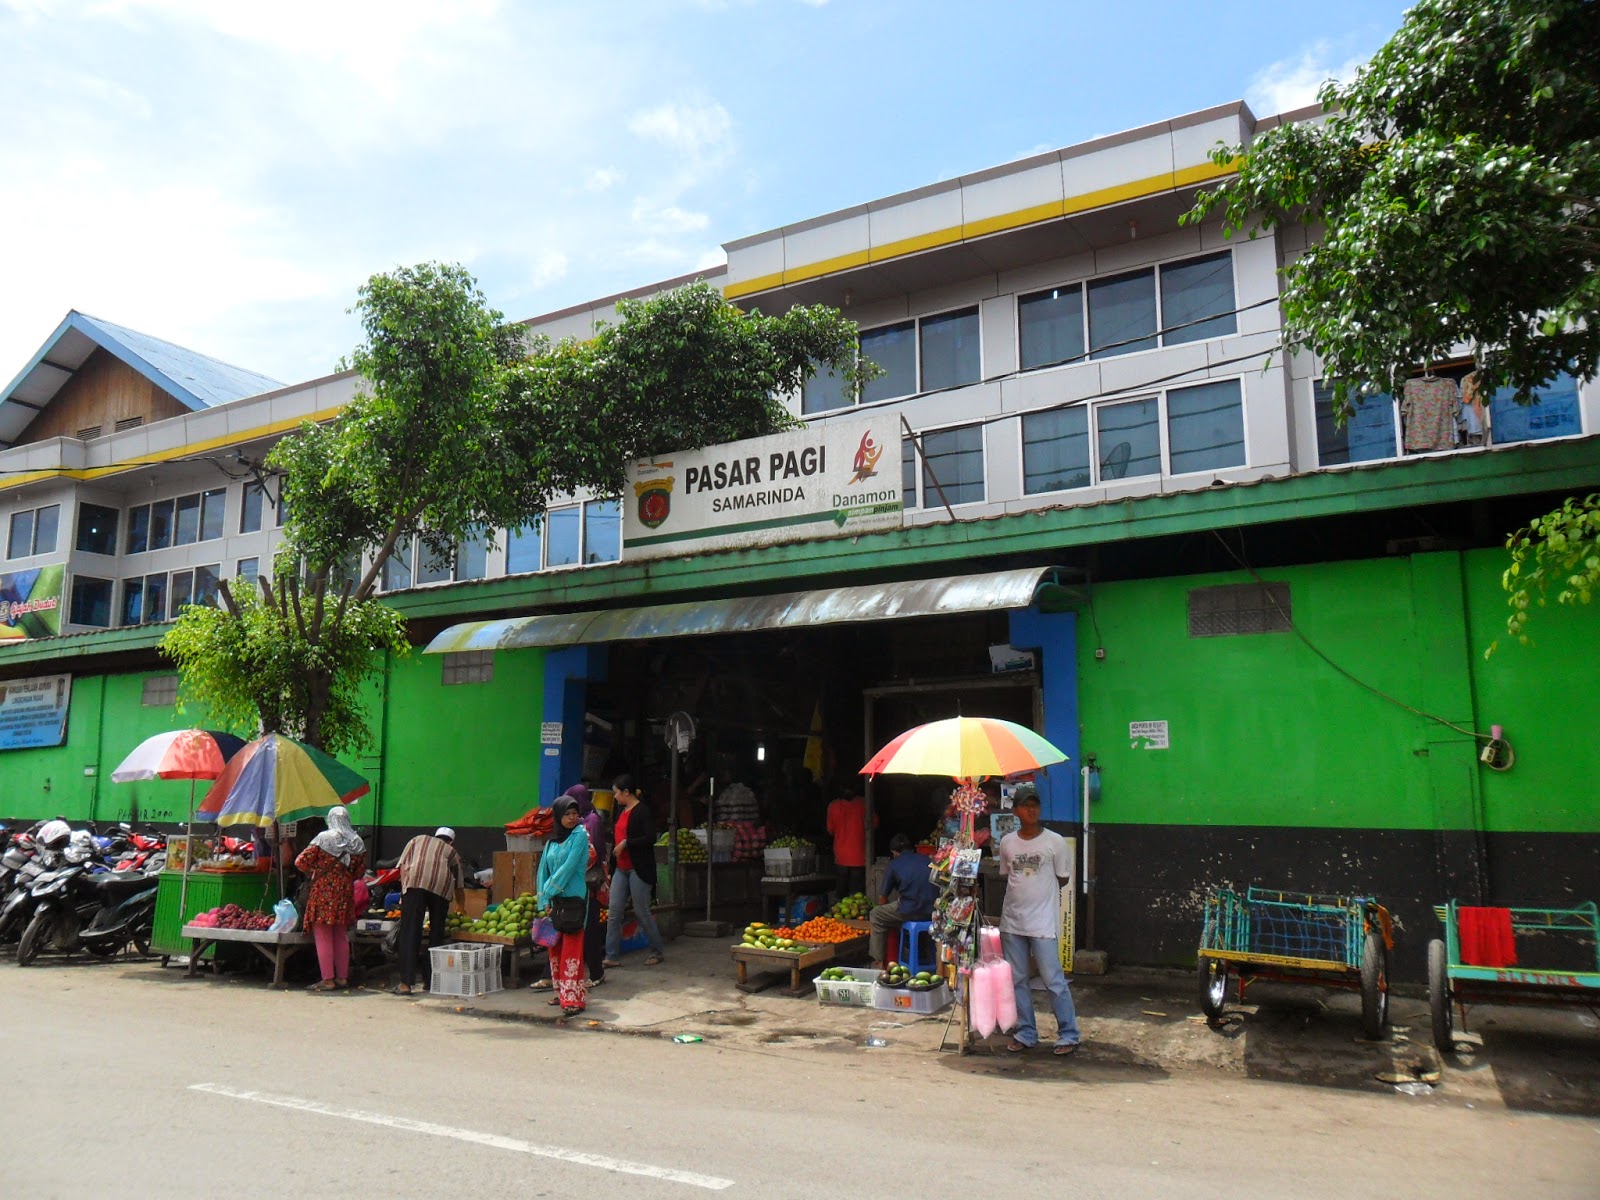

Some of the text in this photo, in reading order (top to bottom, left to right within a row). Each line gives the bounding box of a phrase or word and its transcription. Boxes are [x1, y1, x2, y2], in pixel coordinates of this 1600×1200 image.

[685, 445, 826, 494] PASAR PAGI
[712, 486, 806, 513] SAMARINDA
[832, 489, 896, 508] Danamon
